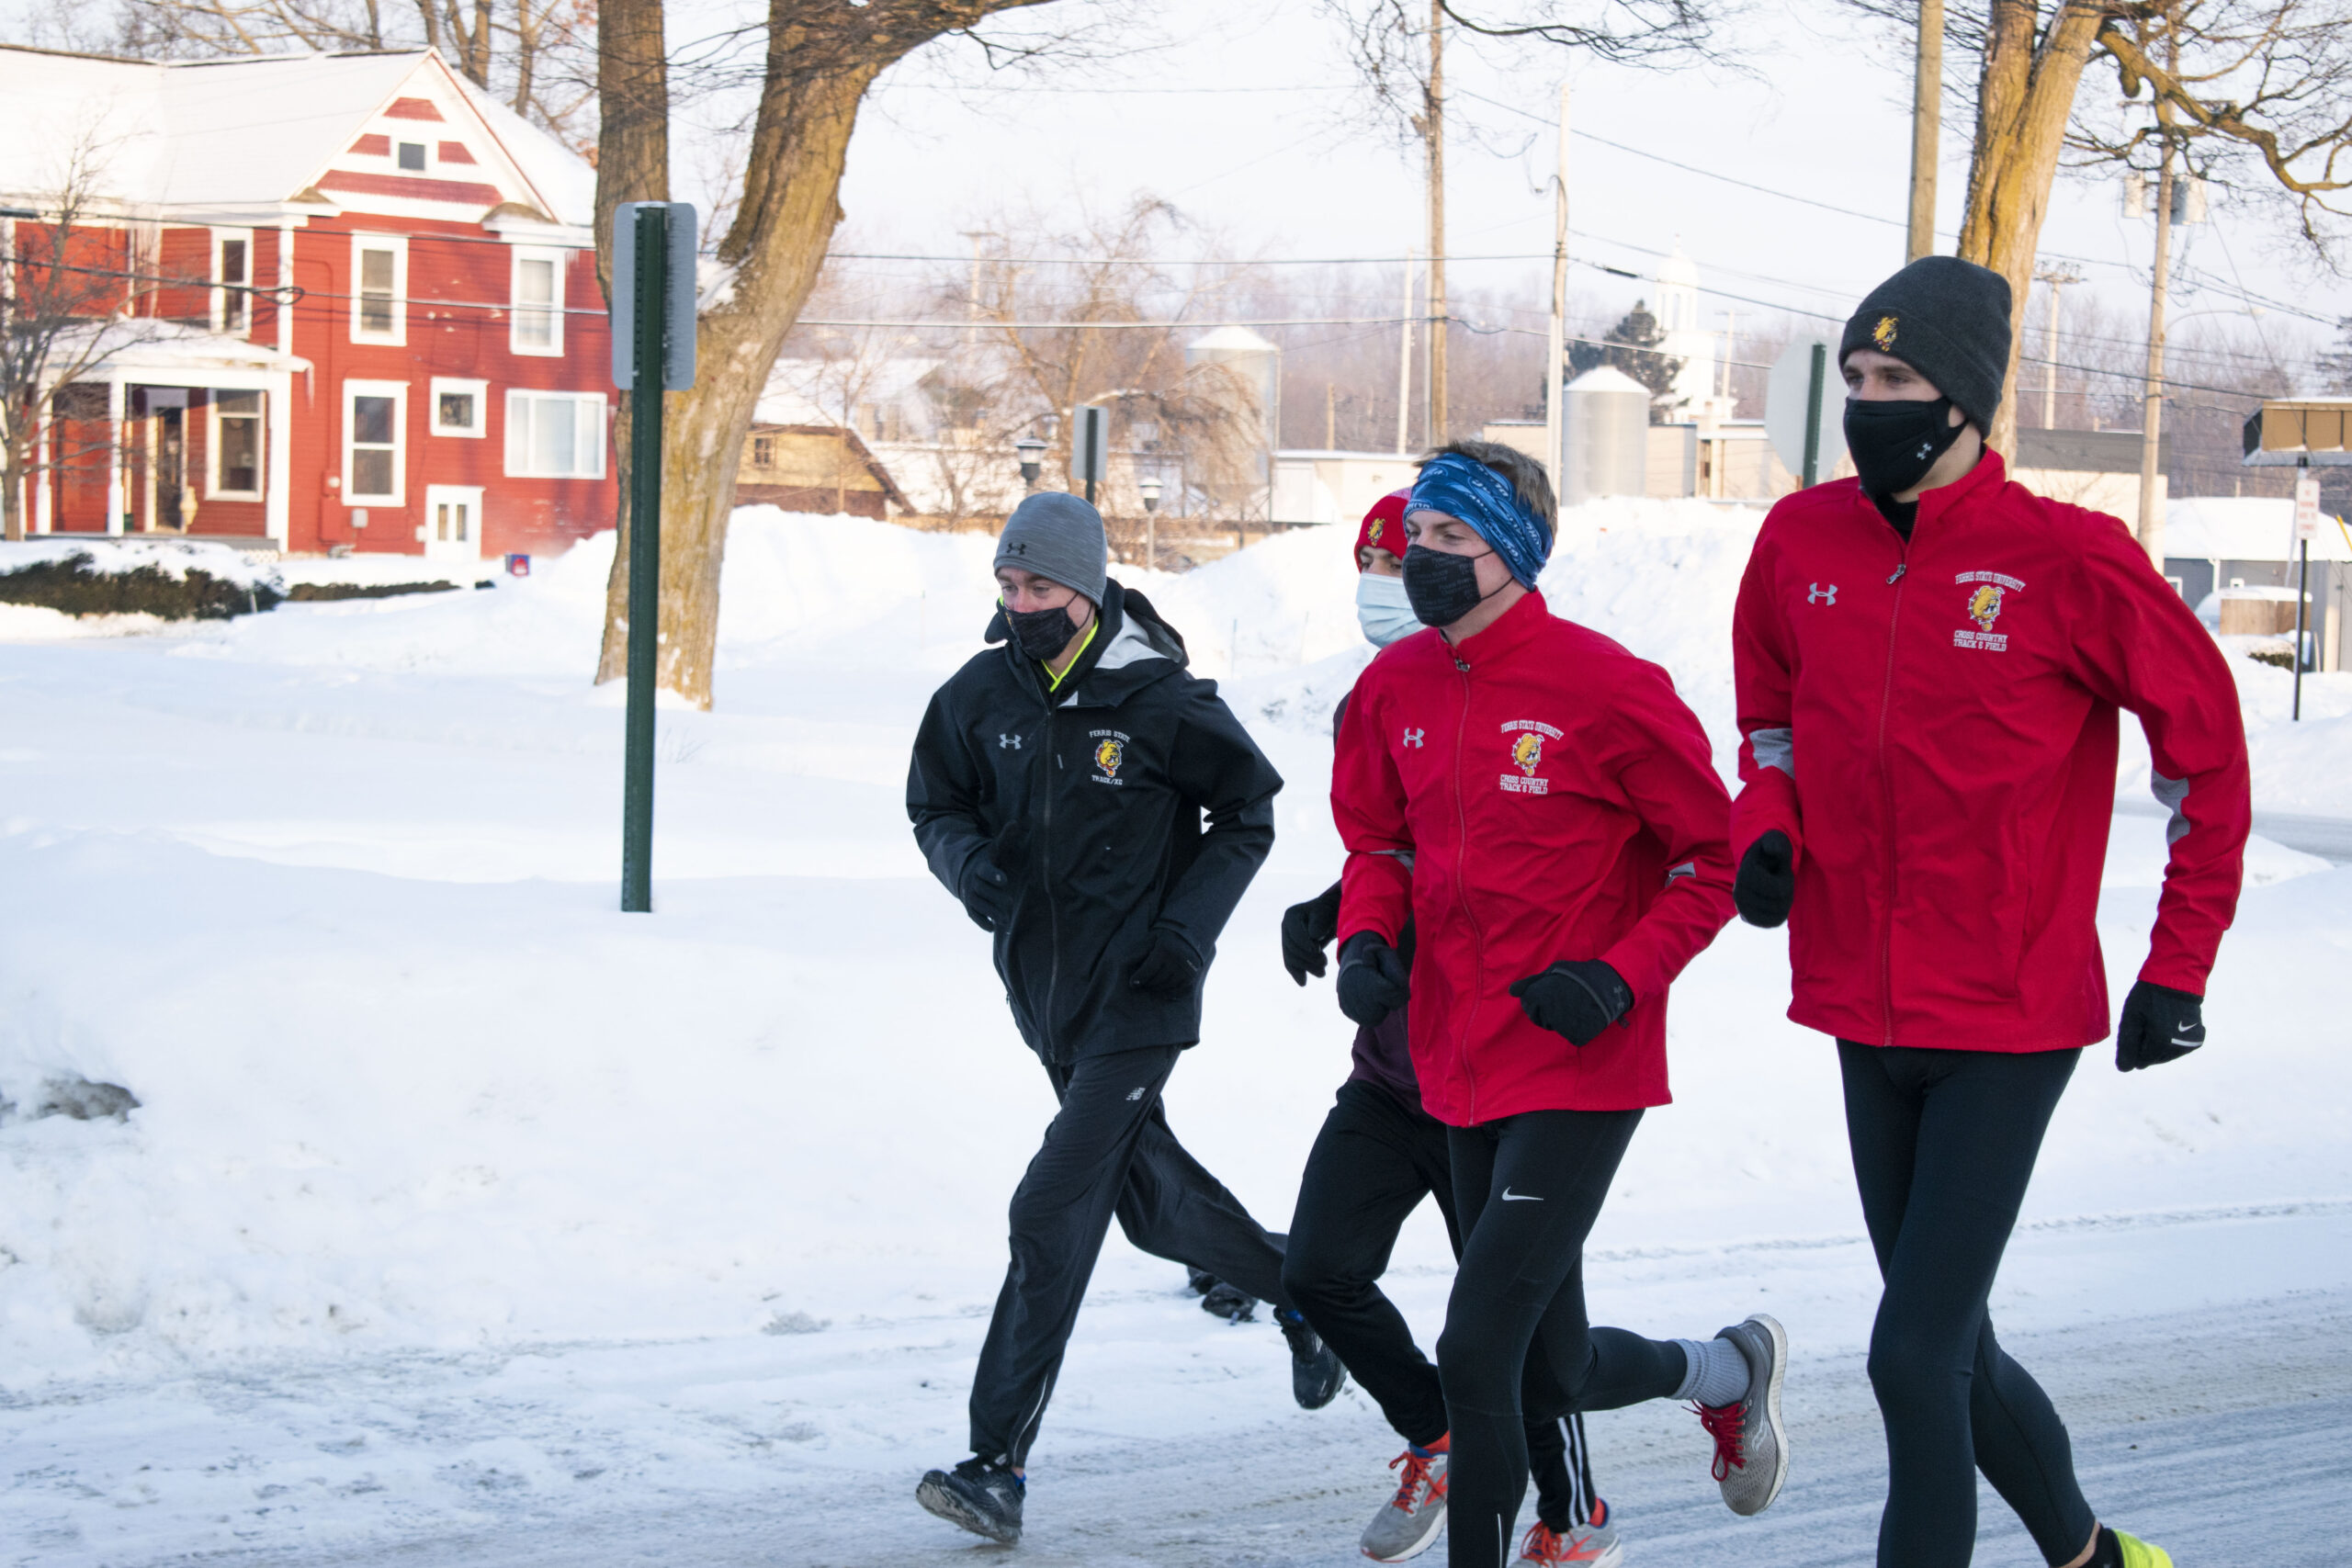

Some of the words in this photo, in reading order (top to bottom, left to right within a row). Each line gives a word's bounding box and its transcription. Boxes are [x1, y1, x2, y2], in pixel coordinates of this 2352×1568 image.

[1975, 570, 1993, 581] STATE
[1954, 630, 1974, 639] CROSS
[1975, 632, 2007, 642] COUNTRY
[1953, 639, 1976, 648] TRACK
[1984, 642, 2007, 651] FIELD
[1519, 720, 1534, 730] STATE
[1090, 729, 1112, 738] FERRIS
[1114, 731, 1130, 743] STATE
[1091, 775, 1123, 785] TRACK/XC
[1500, 774, 1519, 784] CROSS
[1521, 777, 1548, 786] COUNTRY
[1500, 783, 1521, 792] TRACK
[1529, 786, 1548, 795] FIELD
